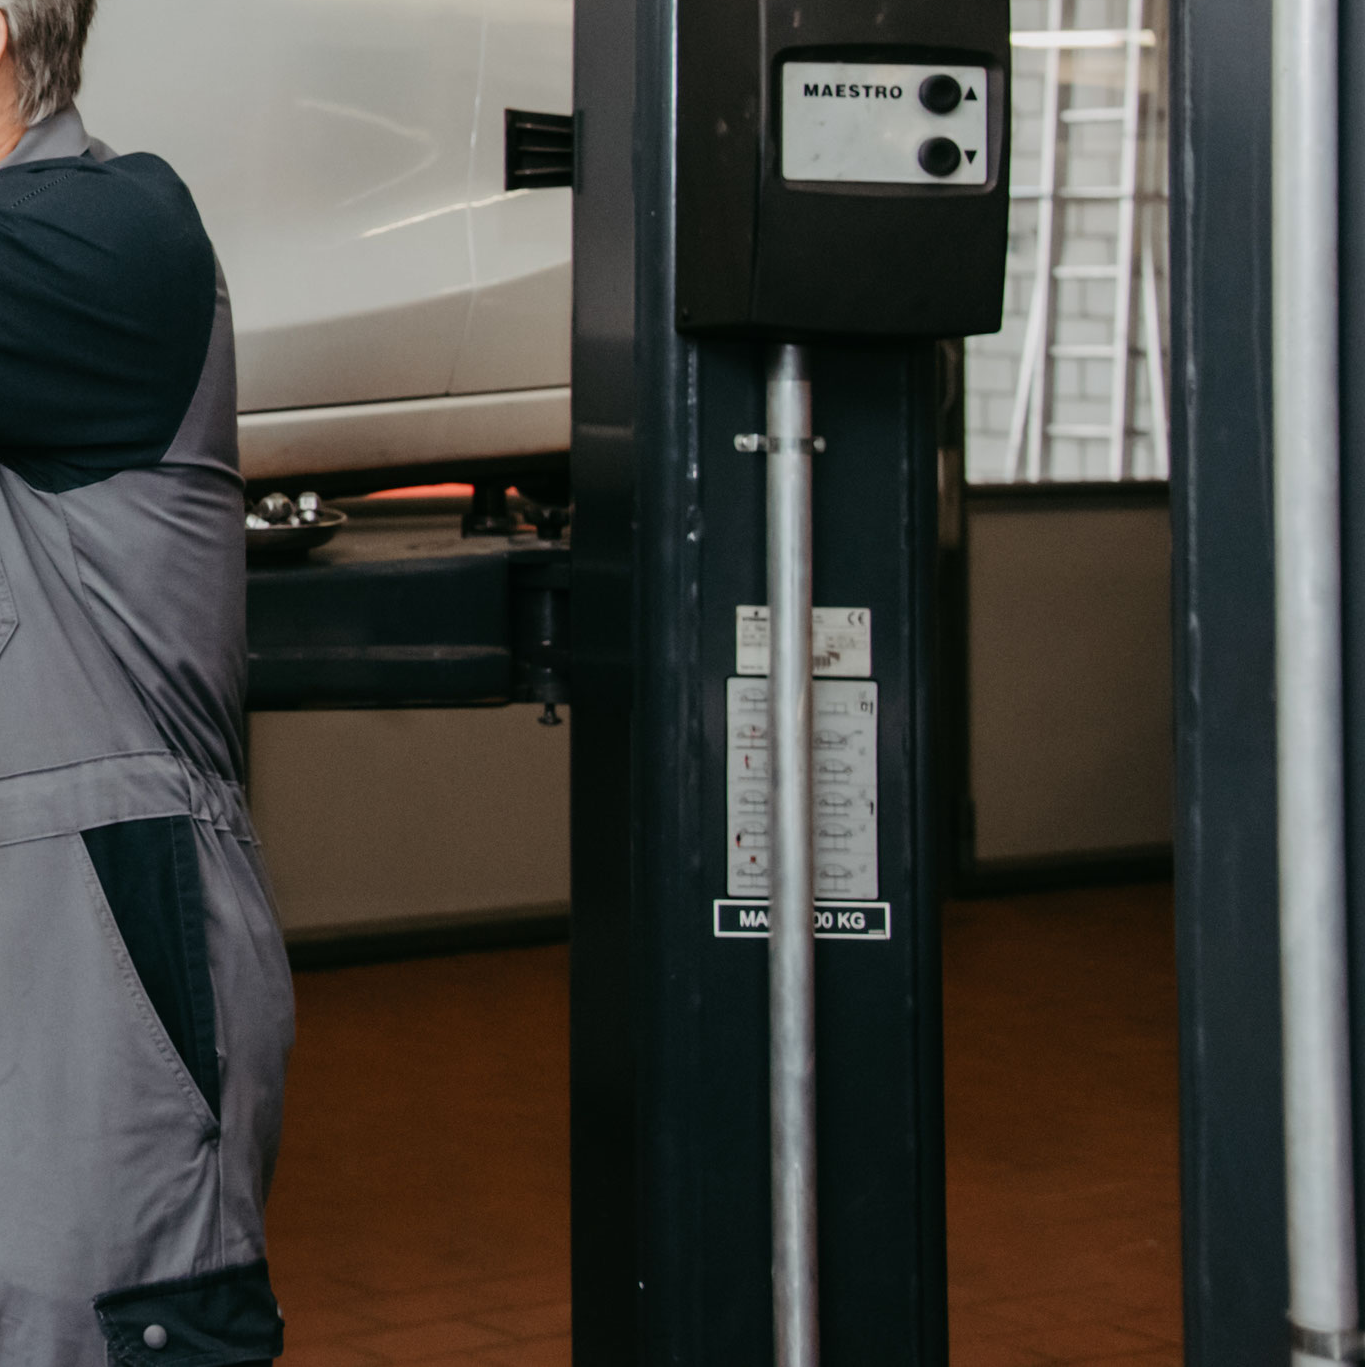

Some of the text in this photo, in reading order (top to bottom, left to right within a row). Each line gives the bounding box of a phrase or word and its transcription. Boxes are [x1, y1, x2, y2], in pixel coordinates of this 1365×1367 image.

[803, 83, 903, 100] MAESTRO
[739, 909, 770, 928] MA
[837, 911, 866, 930] KG
